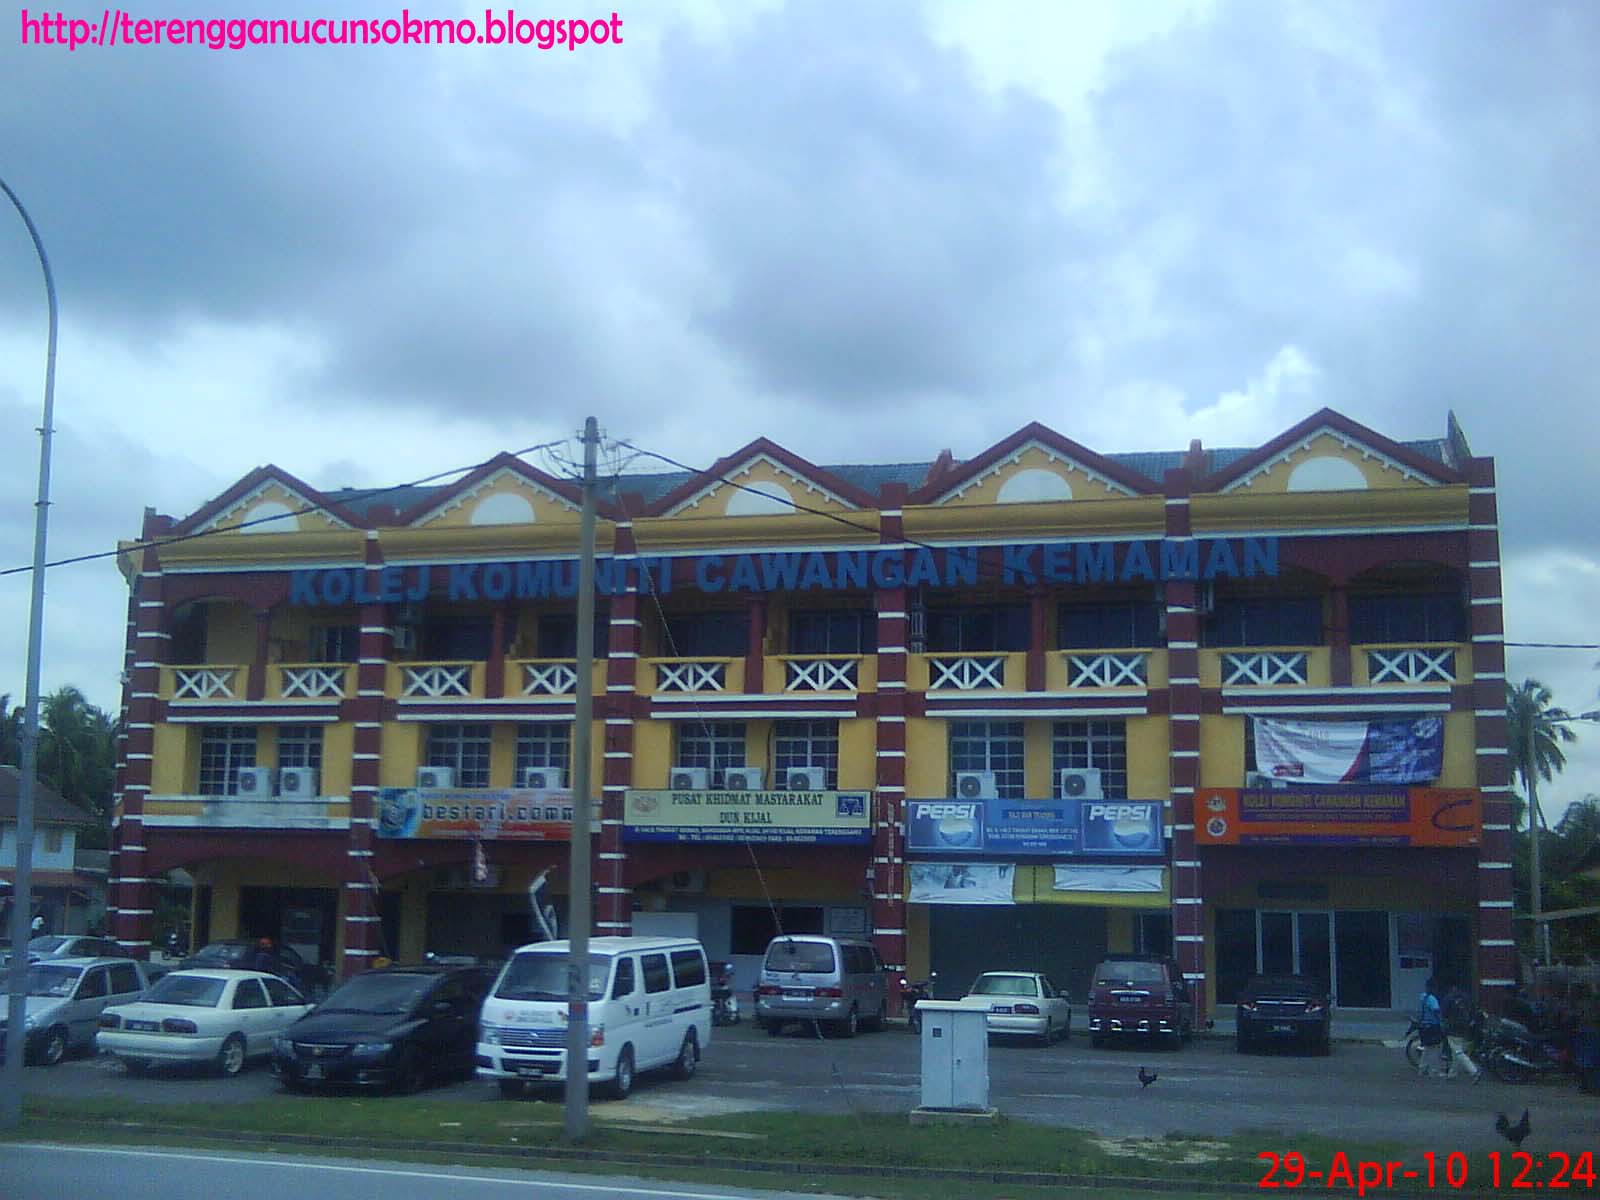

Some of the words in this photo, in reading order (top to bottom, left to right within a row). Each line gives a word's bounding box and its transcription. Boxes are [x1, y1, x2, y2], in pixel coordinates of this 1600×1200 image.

[290, 566, 430, 606] KOLEJ
[448, 557, 672, 601] KOMUNITI
[696, 547, 977, 593] CAWANGAN
[1001, 536, 1280, 587] KEMAMAN
[671, 793, 702, 806] PUSAT
[705, 793, 750, 805] KHIDMAT
[755, 793, 823, 805] MASYARAKAT
[719, 812, 740, 824] DUN
[916, 804, 977, 820] PEPSI
[1089, 805, 1153, 821] PEPSI
